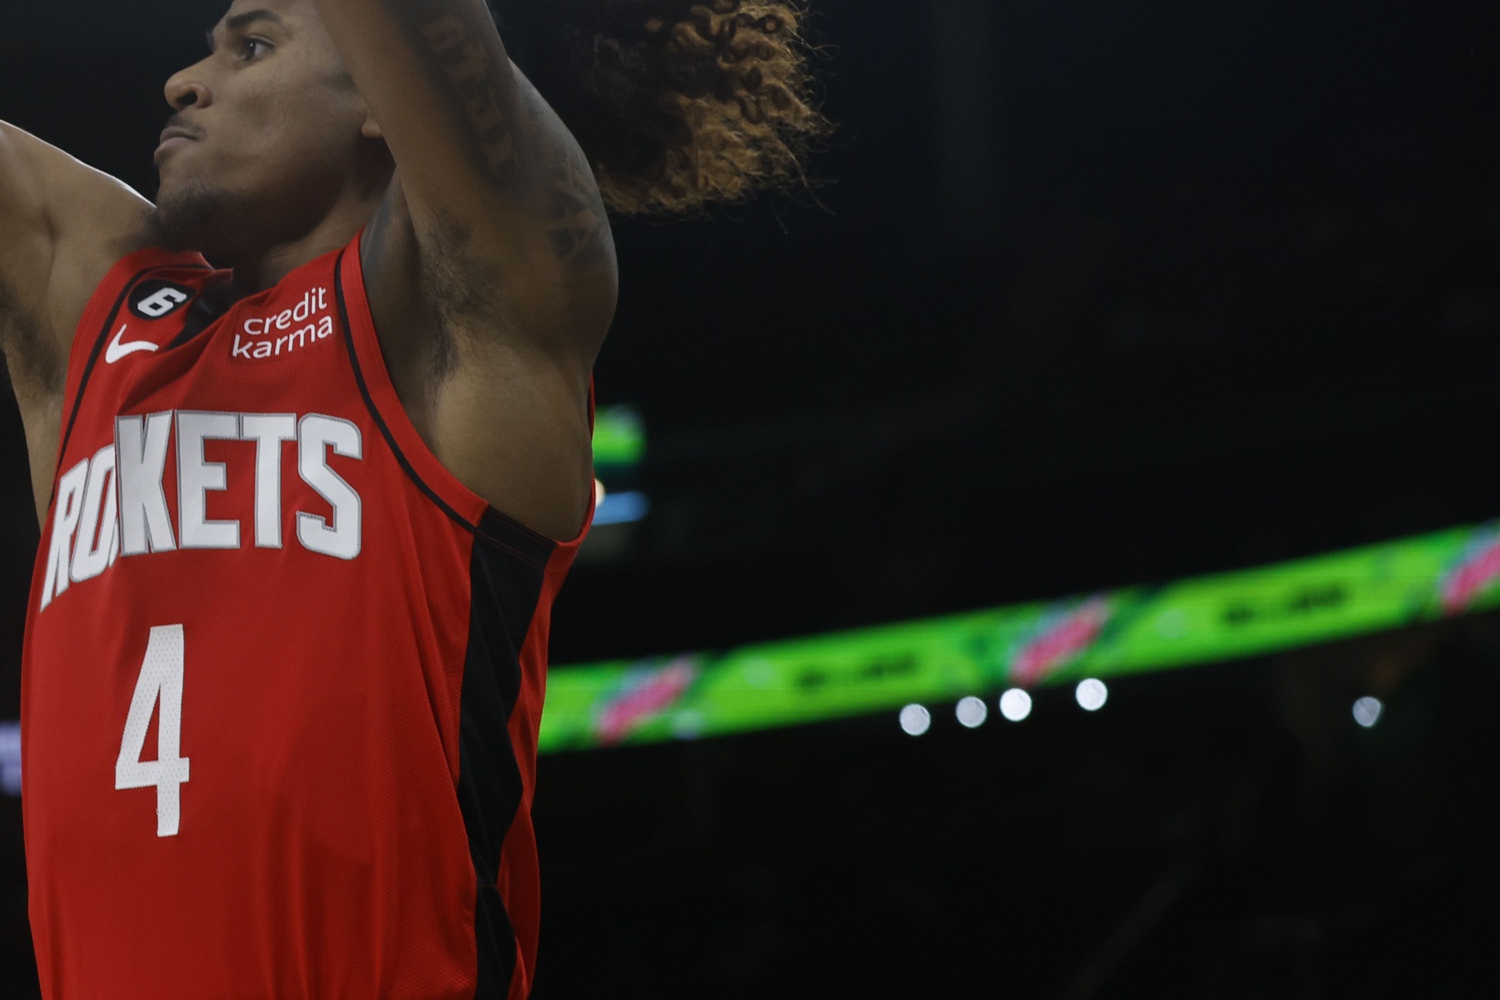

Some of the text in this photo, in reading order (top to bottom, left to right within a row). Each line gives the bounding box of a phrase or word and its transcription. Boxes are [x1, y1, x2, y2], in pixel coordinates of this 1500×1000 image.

[137, 287, 188, 317] 6
[243, 286, 328, 336] credit
[232, 315, 334, 359] karma
[39, 408, 363, 614] ROKETS
[114, 622, 191, 838] 4
